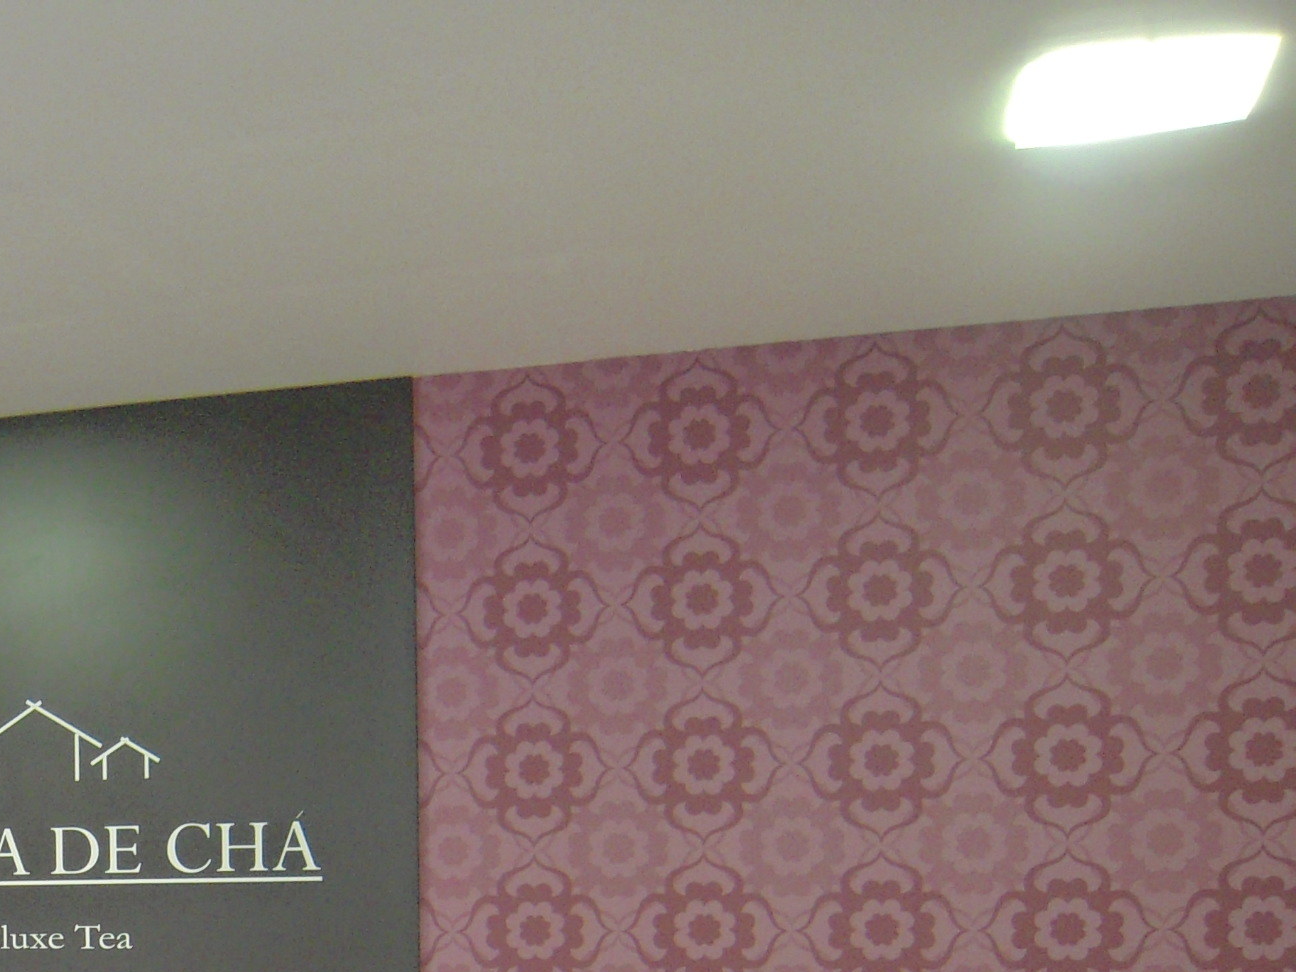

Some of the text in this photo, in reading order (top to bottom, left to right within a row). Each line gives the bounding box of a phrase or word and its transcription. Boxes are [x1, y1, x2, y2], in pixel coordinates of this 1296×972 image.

[50, 824, 142, 875] DE
[166, 810, 322, 873] CHÁ
[73, 923, 134, 950] Tea
